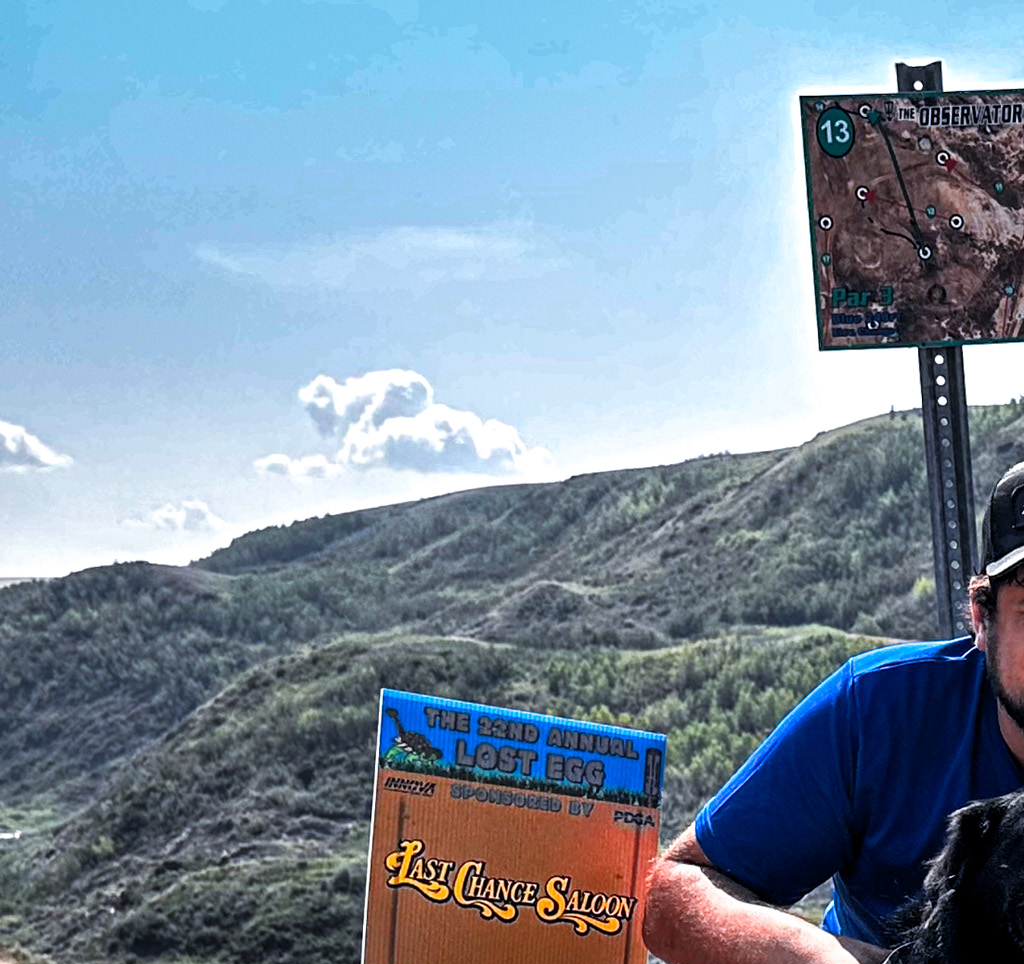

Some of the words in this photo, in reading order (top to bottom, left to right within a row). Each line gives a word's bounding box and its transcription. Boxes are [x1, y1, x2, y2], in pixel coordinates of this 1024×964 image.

[898, 107, 916, 121] THE
[820, 119, 850, 144] 13
[831, 287, 871, 308] Par
[880, 286, 894, 306] 3
[424, 707, 470, 733] THE
[477, 716, 539, 743] 22ND
[546, 727, 639, 760] ANNUAL
[455, 740, 537, 776] LOST
[546, 754, 606, 787] EGG
[384, 777, 436, 797] INNOVA
[450, 784, 562, 812] SPONSORED
[569, 800, 594, 818] BY
[613, 810, 655, 827] PDGA
[384, 839, 455, 903] LAST
[453, 859, 539, 923] CHANCE
[535, 875, 636, 936] SALOON
